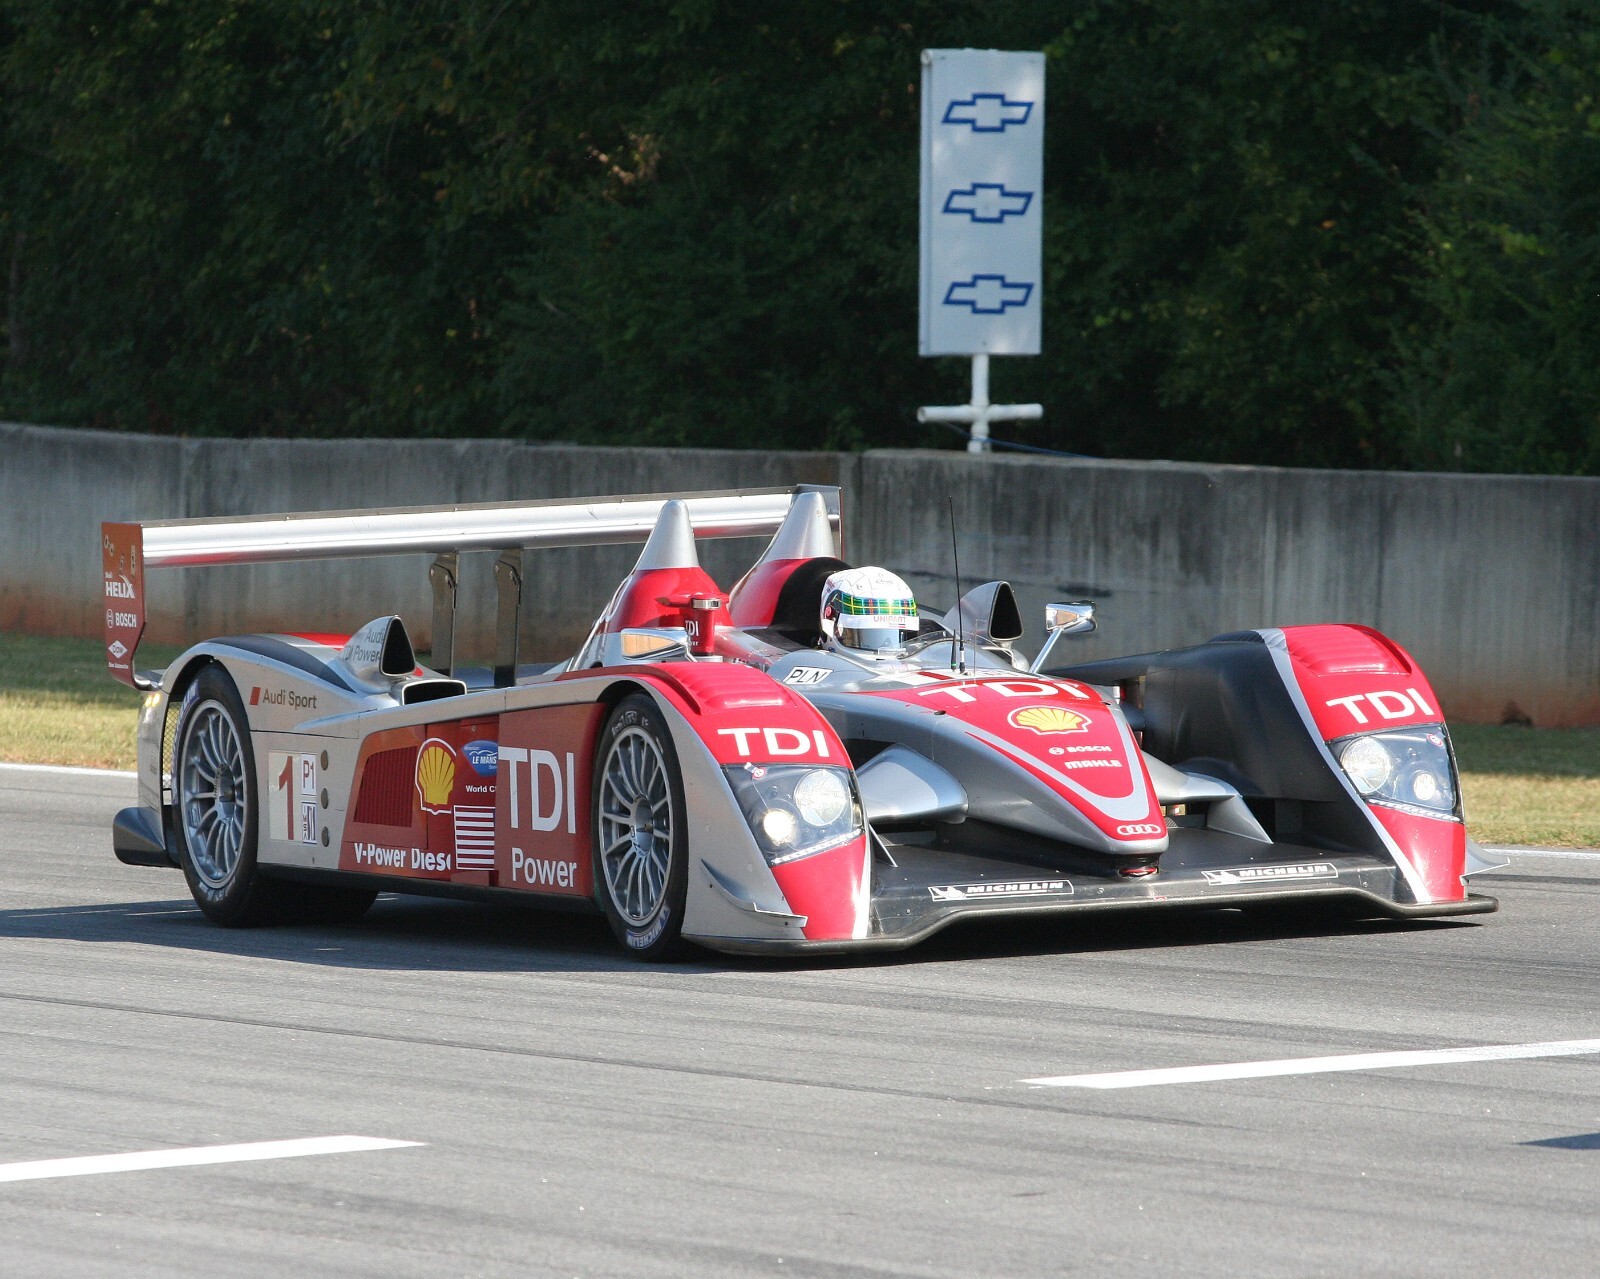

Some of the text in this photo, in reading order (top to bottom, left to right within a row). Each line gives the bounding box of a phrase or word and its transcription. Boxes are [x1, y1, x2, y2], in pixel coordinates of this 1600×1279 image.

[105, 581, 136, 599] HELIX
[115, 612, 137, 628] BOSCH
[873, 615, 907, 623] UNIPART
[353, 645, 381, 662] Power
[786, 669, 828, 683] PLN
[262, 688, 317, 711] Audi Sport
[917, 680, 1091, 703] TDI
[1325, 687, 1436, 724] TDI
[716, 727, 831, 758] TDI
[1065, 745, 1113, 753] BOSCH
[472, 756, 480, 765] LE
[1063, 759, 1123, 770] MAHLE
[303, 760, 315, 790] P1
[465, 784, 497, 793] World C
[498, 745, 577, 834] TDI
[278, 755, 295, 841] 1
[354, 842, 407, 868] V-Power
[511, 847, 578, 888] Power
[1239, 865, 1329, 878] MICHELIN
[966, 881, 1064, 894] MICHELIN
